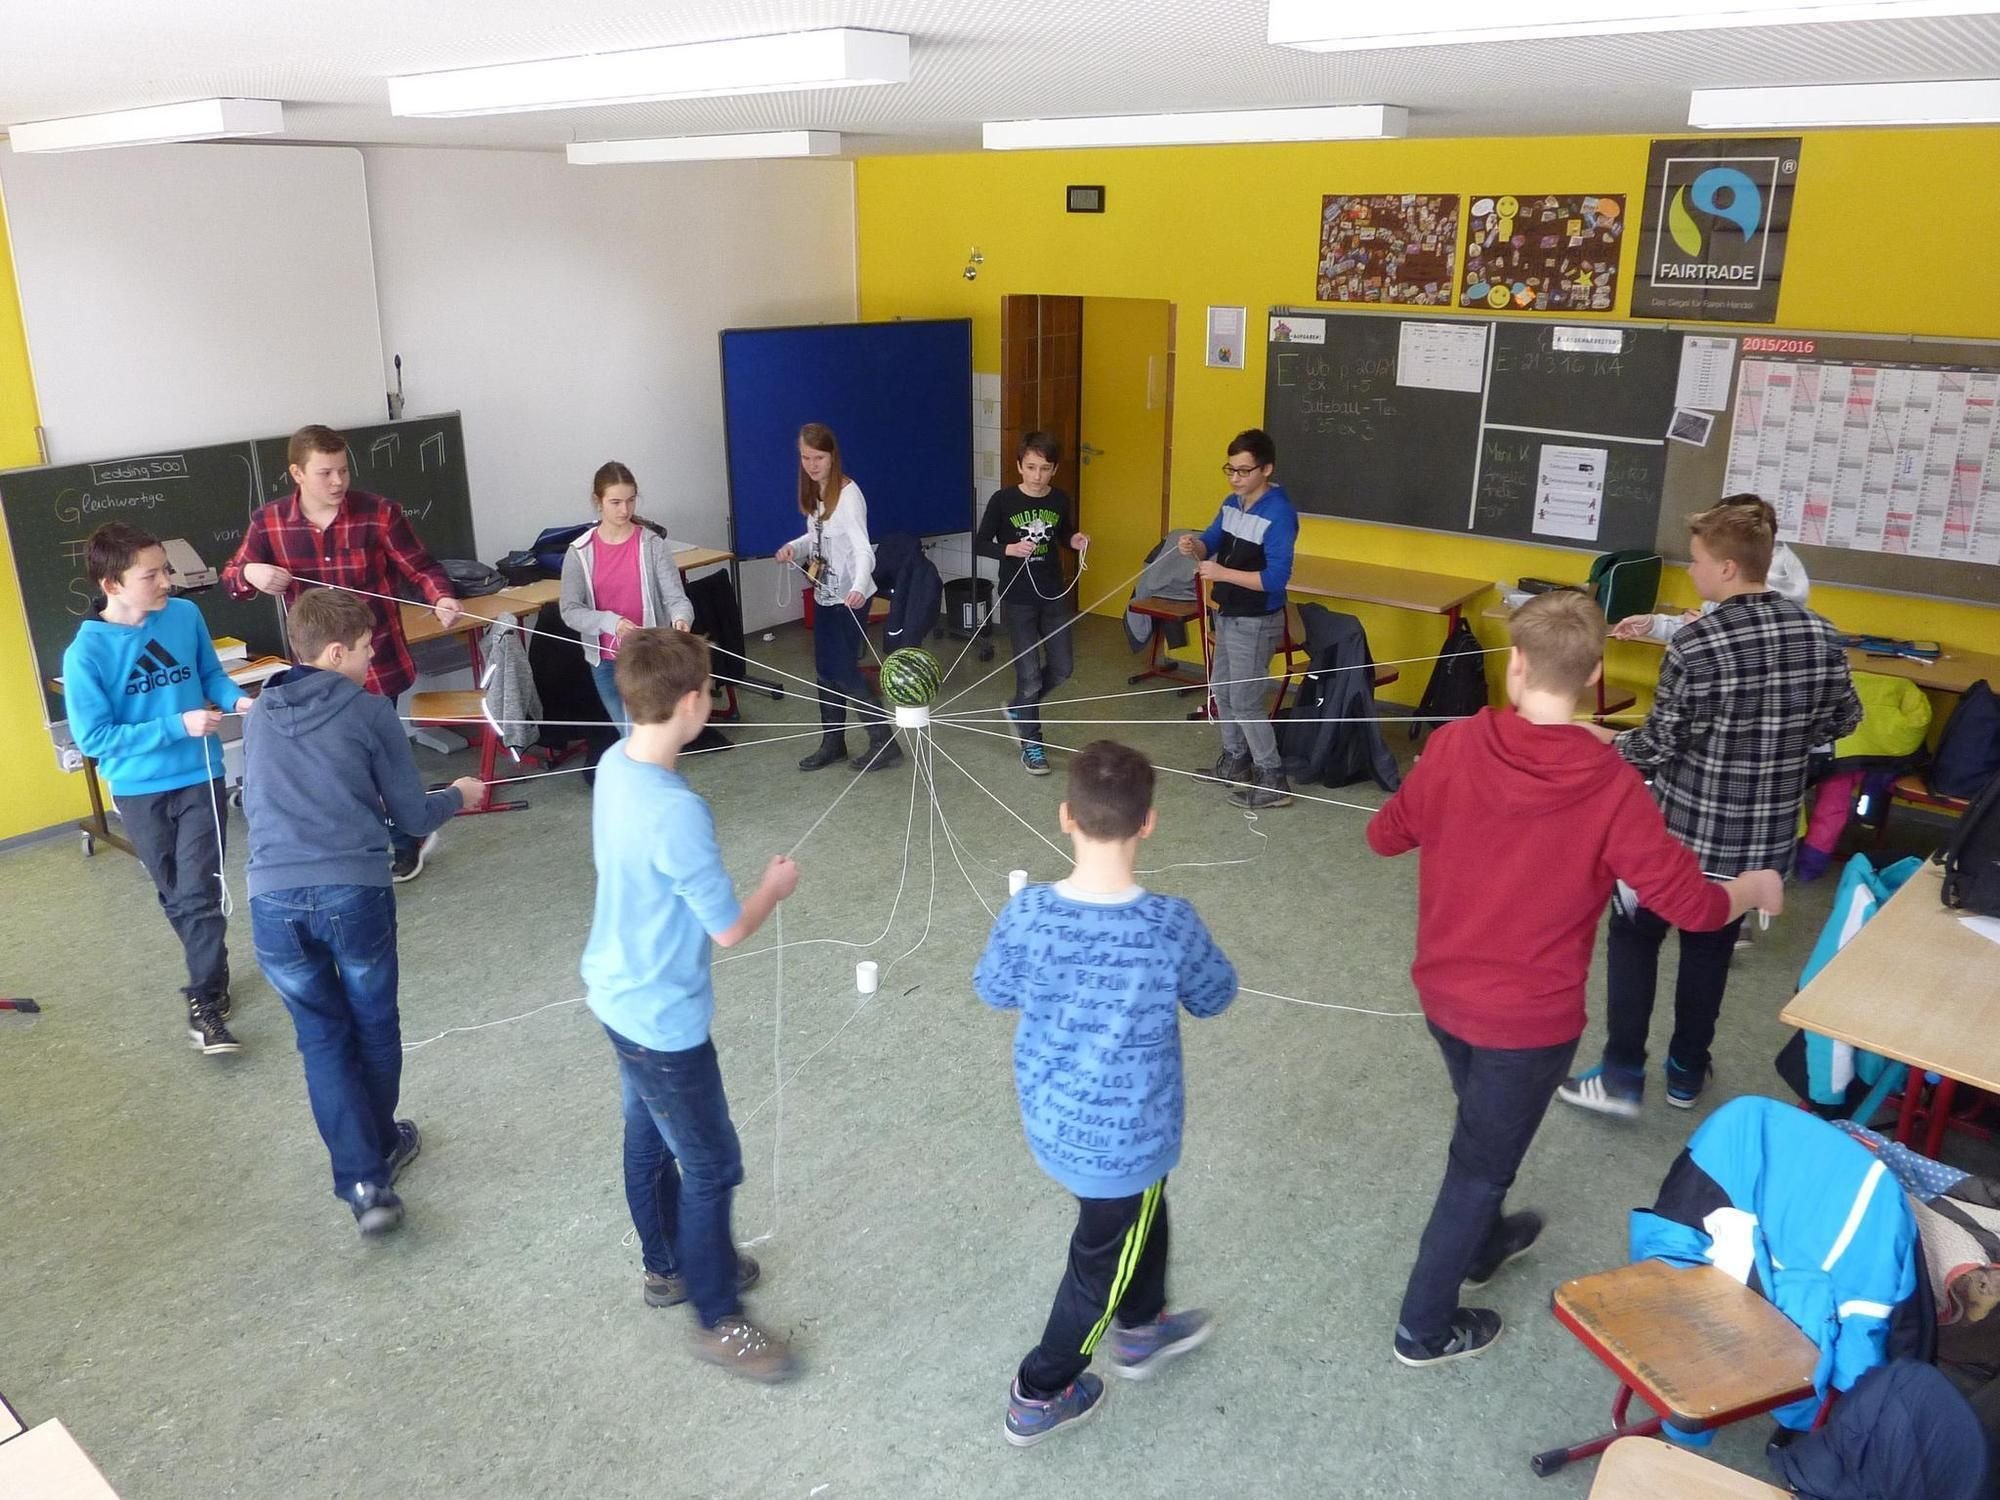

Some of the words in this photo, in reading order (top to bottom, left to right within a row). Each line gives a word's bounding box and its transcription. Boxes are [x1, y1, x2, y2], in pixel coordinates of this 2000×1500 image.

[1659, 263, 1755, 280] FAIRTRADE
[1743, 337, 1815, 353] 2015/2016
[100, 467, 151, 480] edding
[54, 487, 166, 524] Gleichwertige
[1010, 510, 1032, 529] WILD
[125, 666, 193, 696] adidas
